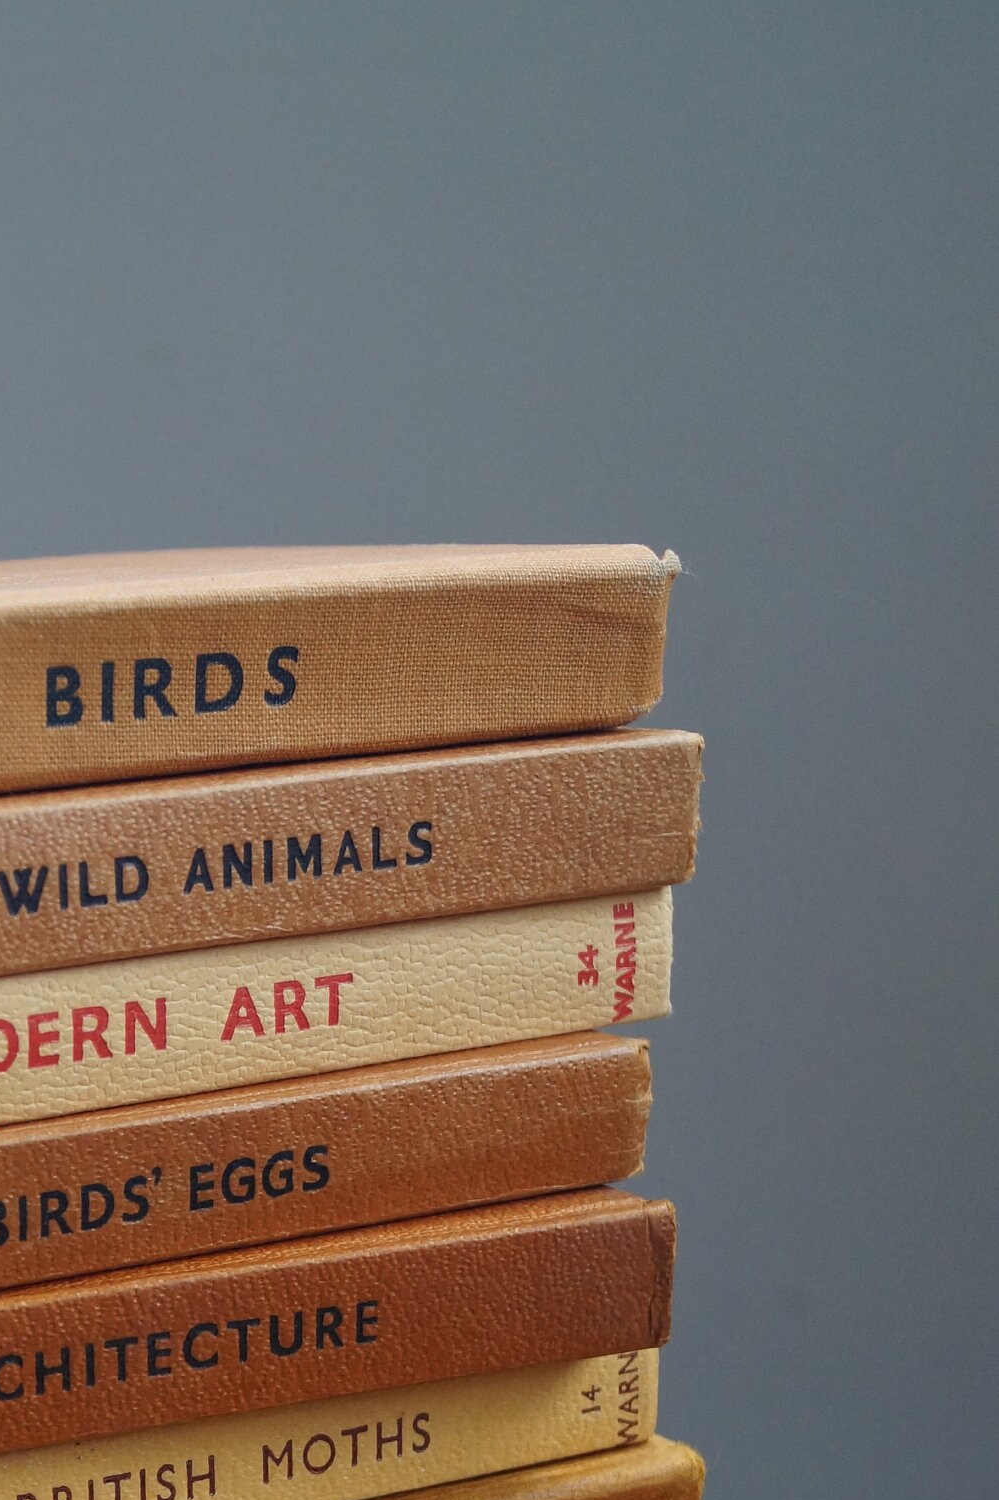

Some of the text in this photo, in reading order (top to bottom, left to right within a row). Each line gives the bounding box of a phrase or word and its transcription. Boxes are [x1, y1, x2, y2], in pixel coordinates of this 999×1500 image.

[45, 645, 299, 728] BIRDS
[183, 821, 433, 895] ANIMALS
[577, 944, 599, 988] 34
[612, 901, 637, 1024] WARNE
[220, 972, 354, 1043] ART
[189, 1145, 331, 1213] EGGS
[581, 1385, 602, 1415] 14
[617, 1350, 640, 1445] WARN
[262, 1412, 432, 1485] MOTHS
